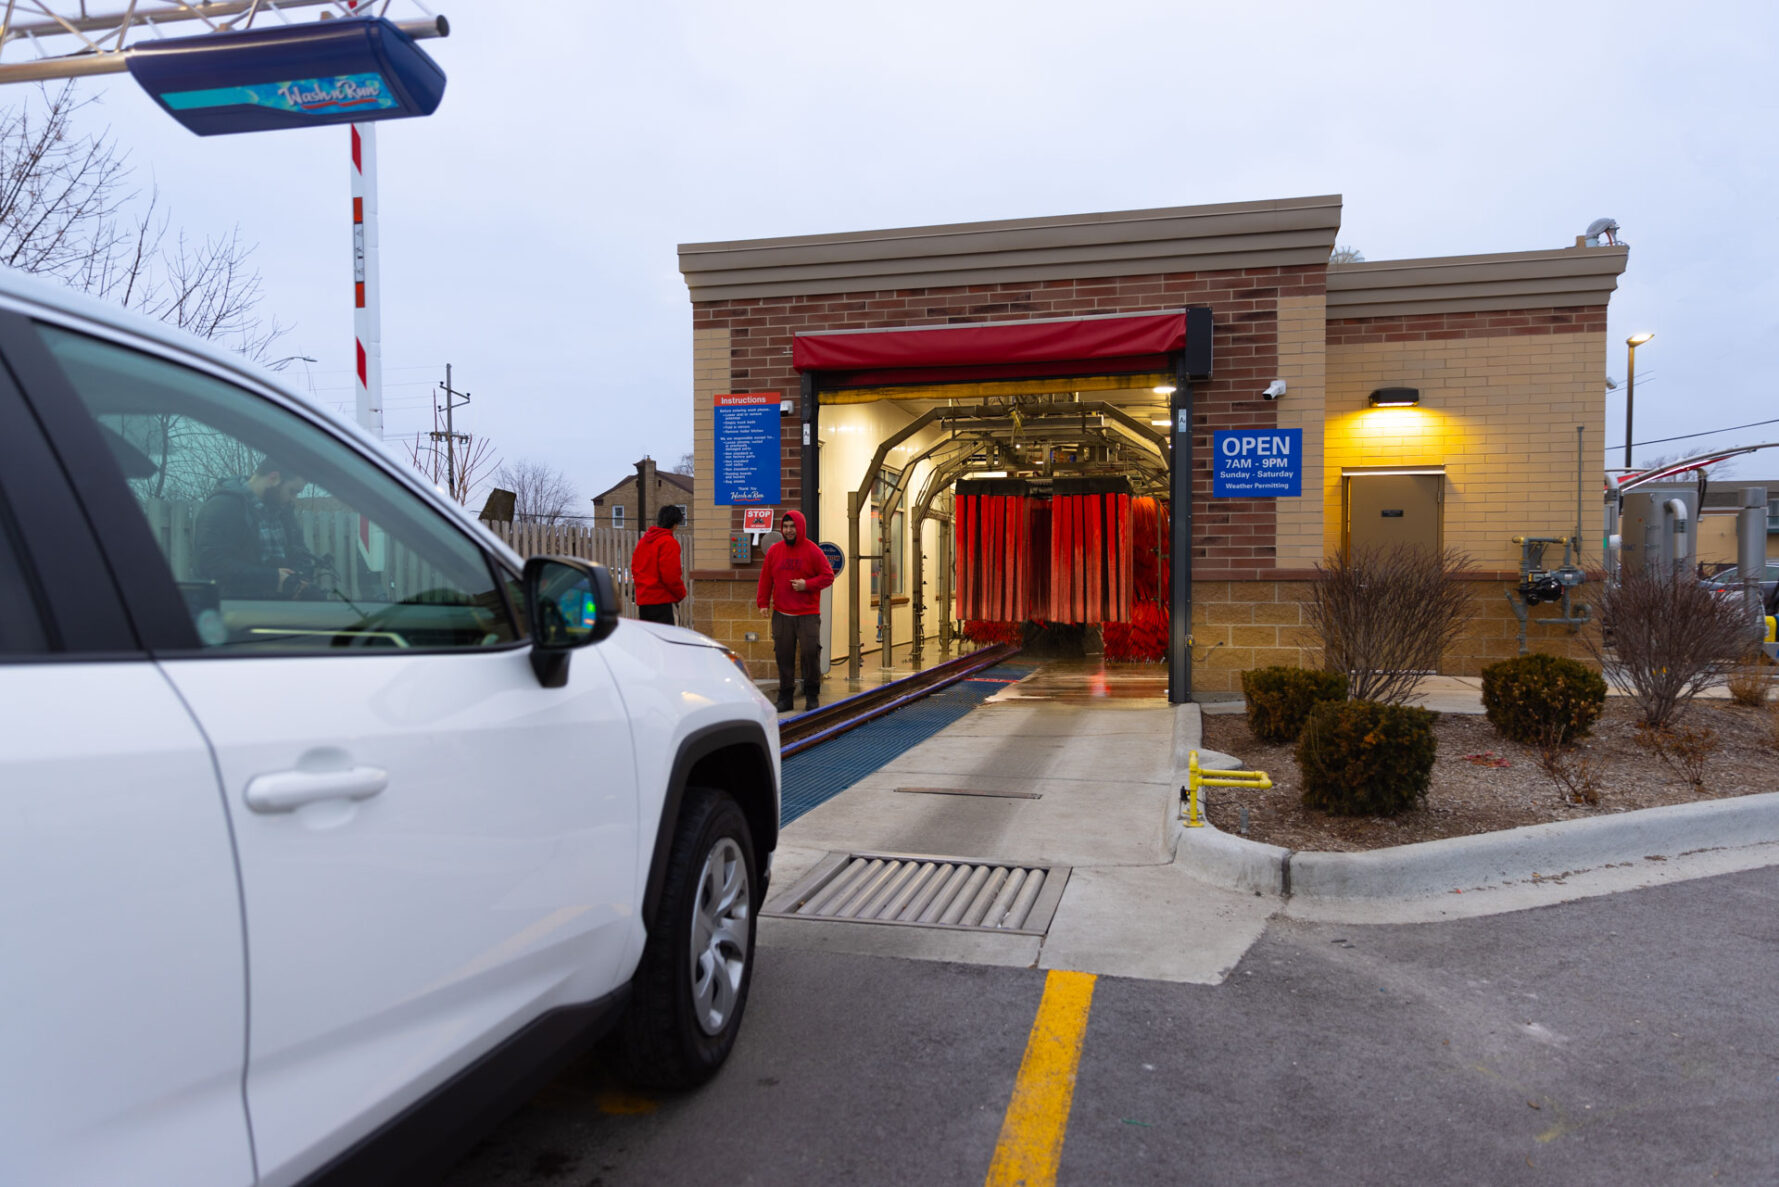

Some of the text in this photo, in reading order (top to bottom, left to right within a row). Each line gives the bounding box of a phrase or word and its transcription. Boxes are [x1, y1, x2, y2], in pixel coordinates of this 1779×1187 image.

[278, 83, 329, 106] Wash
[336, 79, 380, 98] Run
[721, 396, 767, 404] Instructions
[1222, 436, 1290, 456] OPEN
[1225, 458, 1252, 469] 7AM
[1262, 457, 1288, 468] 9PM
[1220, 471, 1250, 479] Sunday
[1257, 470, 1294, 479] Saturday
[1254, 482, 1289, 490] Permitting
[747, 510, 771, 518] STOP
